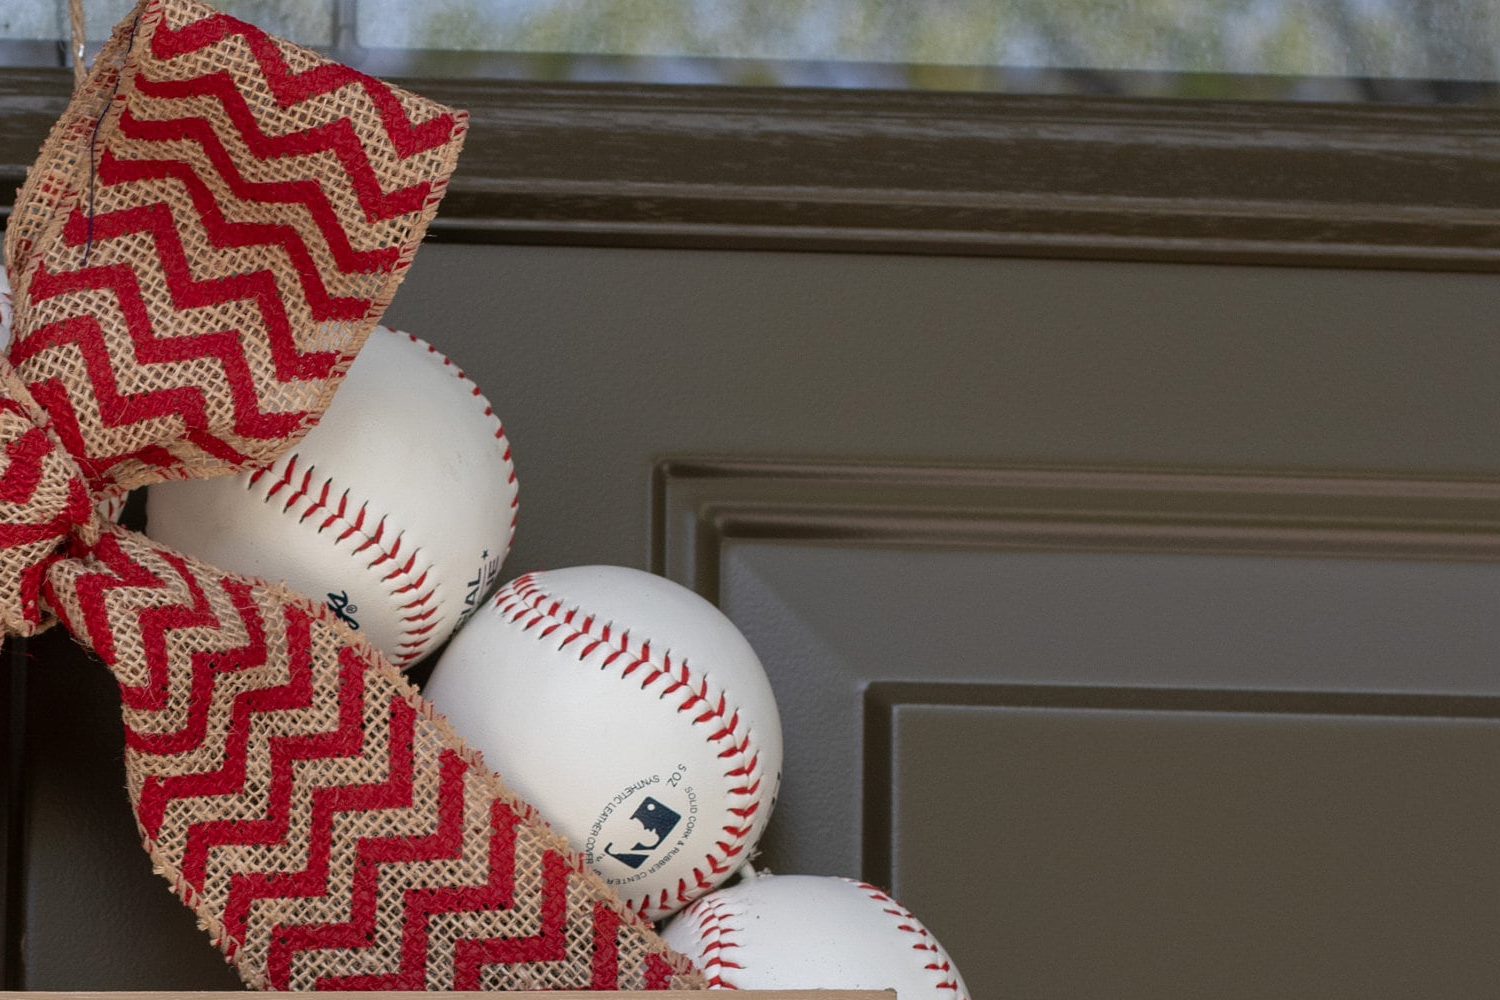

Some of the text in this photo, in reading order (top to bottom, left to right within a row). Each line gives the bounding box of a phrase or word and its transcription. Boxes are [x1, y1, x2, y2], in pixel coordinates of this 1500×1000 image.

[613, 774, 660, 805] SYNTHETIC
[684, 786, 698, 814] SOLID
[590, 802, 617, 837] LEATHER
[681, 816, 697, 840] CORK
[648, 846, 680, 874] RUBBER
[607, 871, 647, 885] CENTER
